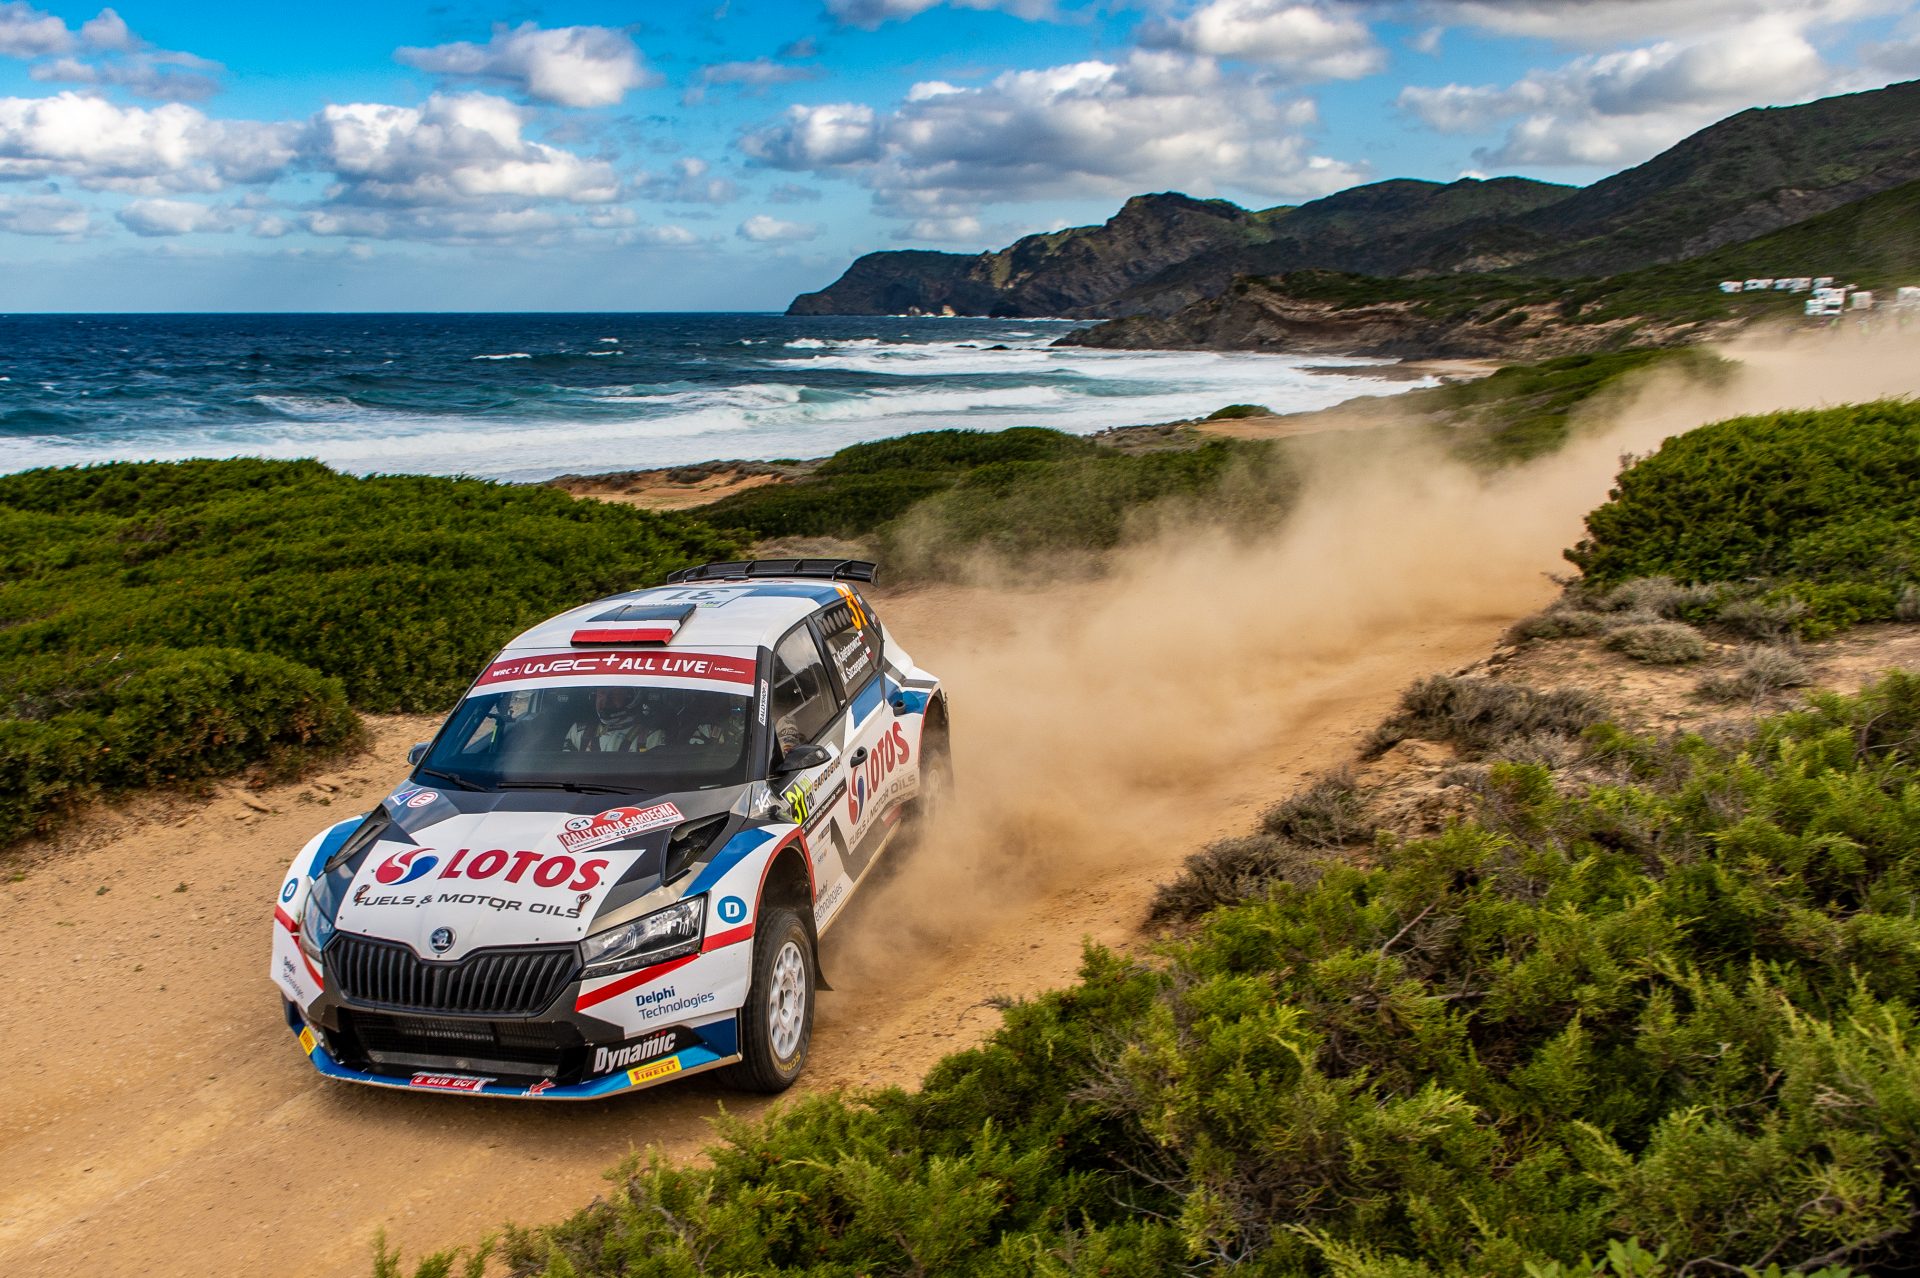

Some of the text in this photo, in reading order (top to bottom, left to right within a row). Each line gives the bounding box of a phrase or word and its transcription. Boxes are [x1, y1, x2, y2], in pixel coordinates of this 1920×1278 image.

[663, 590, 731, 601] 31
[835, 586, 868, 630] 31
[493, 668, 512, 677] WRC
[618, 658, 653, 671] ALL
[662, 660, 709, 673] LIVE
[865, 721, 910, 801] LOTOS
[890, 774, 916, 794] OILS
[786, 784, 808, 825] 31
[563, 829, 595, 847] RALLY
[595, 821, 625, 837] ITALIA
[625, 802, 677, 827] SARDEGNA
[571, 819, 590, 830] 31
[615, 827, 638, 837] 2020
[437, 849, 610, 892] LOTOS
[354, 893, 581, 919] FUELS & MOTOR OILS
[724, 902, 740, 918] D
[814, 883, 843, 922] echnologies
[635, 985, 676, 1007] Delphi
[638, 991, 715, 1020] Technologies
[592, 1031, 677, 1074] Dynamic
[633, 1058, 677, 1081] PIRELLI
